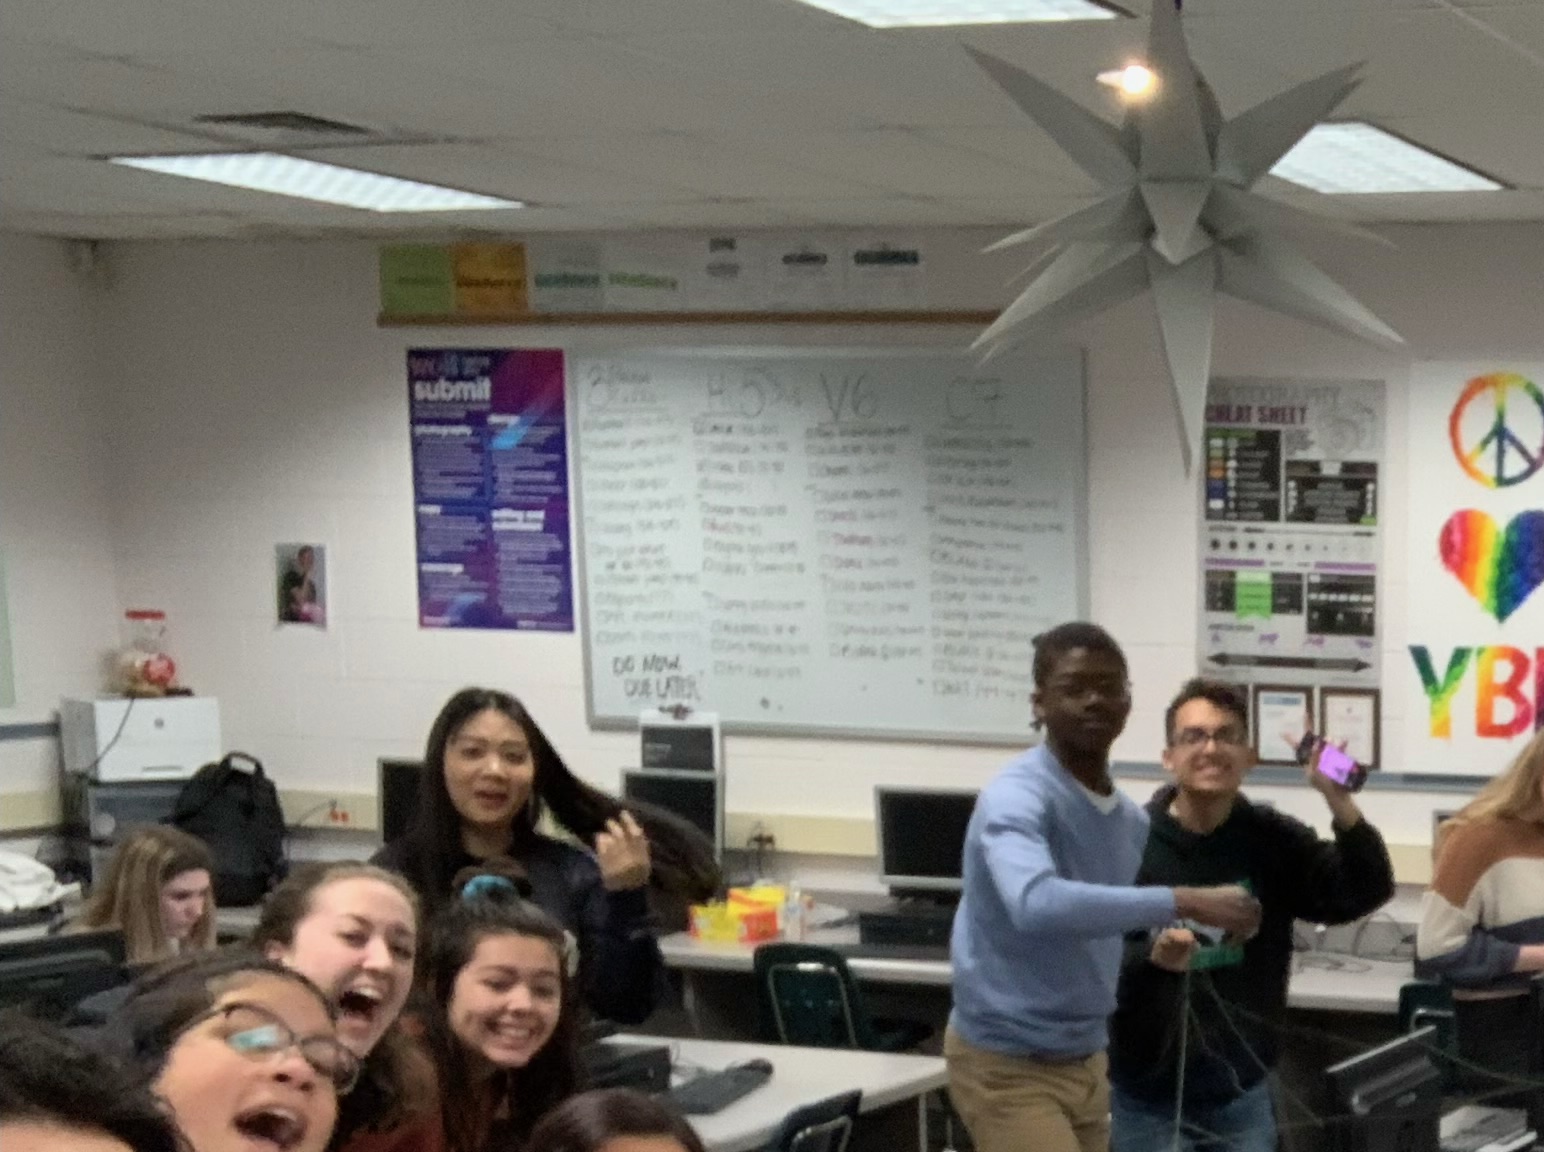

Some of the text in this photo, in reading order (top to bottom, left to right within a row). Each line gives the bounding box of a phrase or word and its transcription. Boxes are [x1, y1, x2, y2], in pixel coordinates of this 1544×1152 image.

[414, 376, 491, 402] submit
[613, 655, 681, 675] DO NOW
